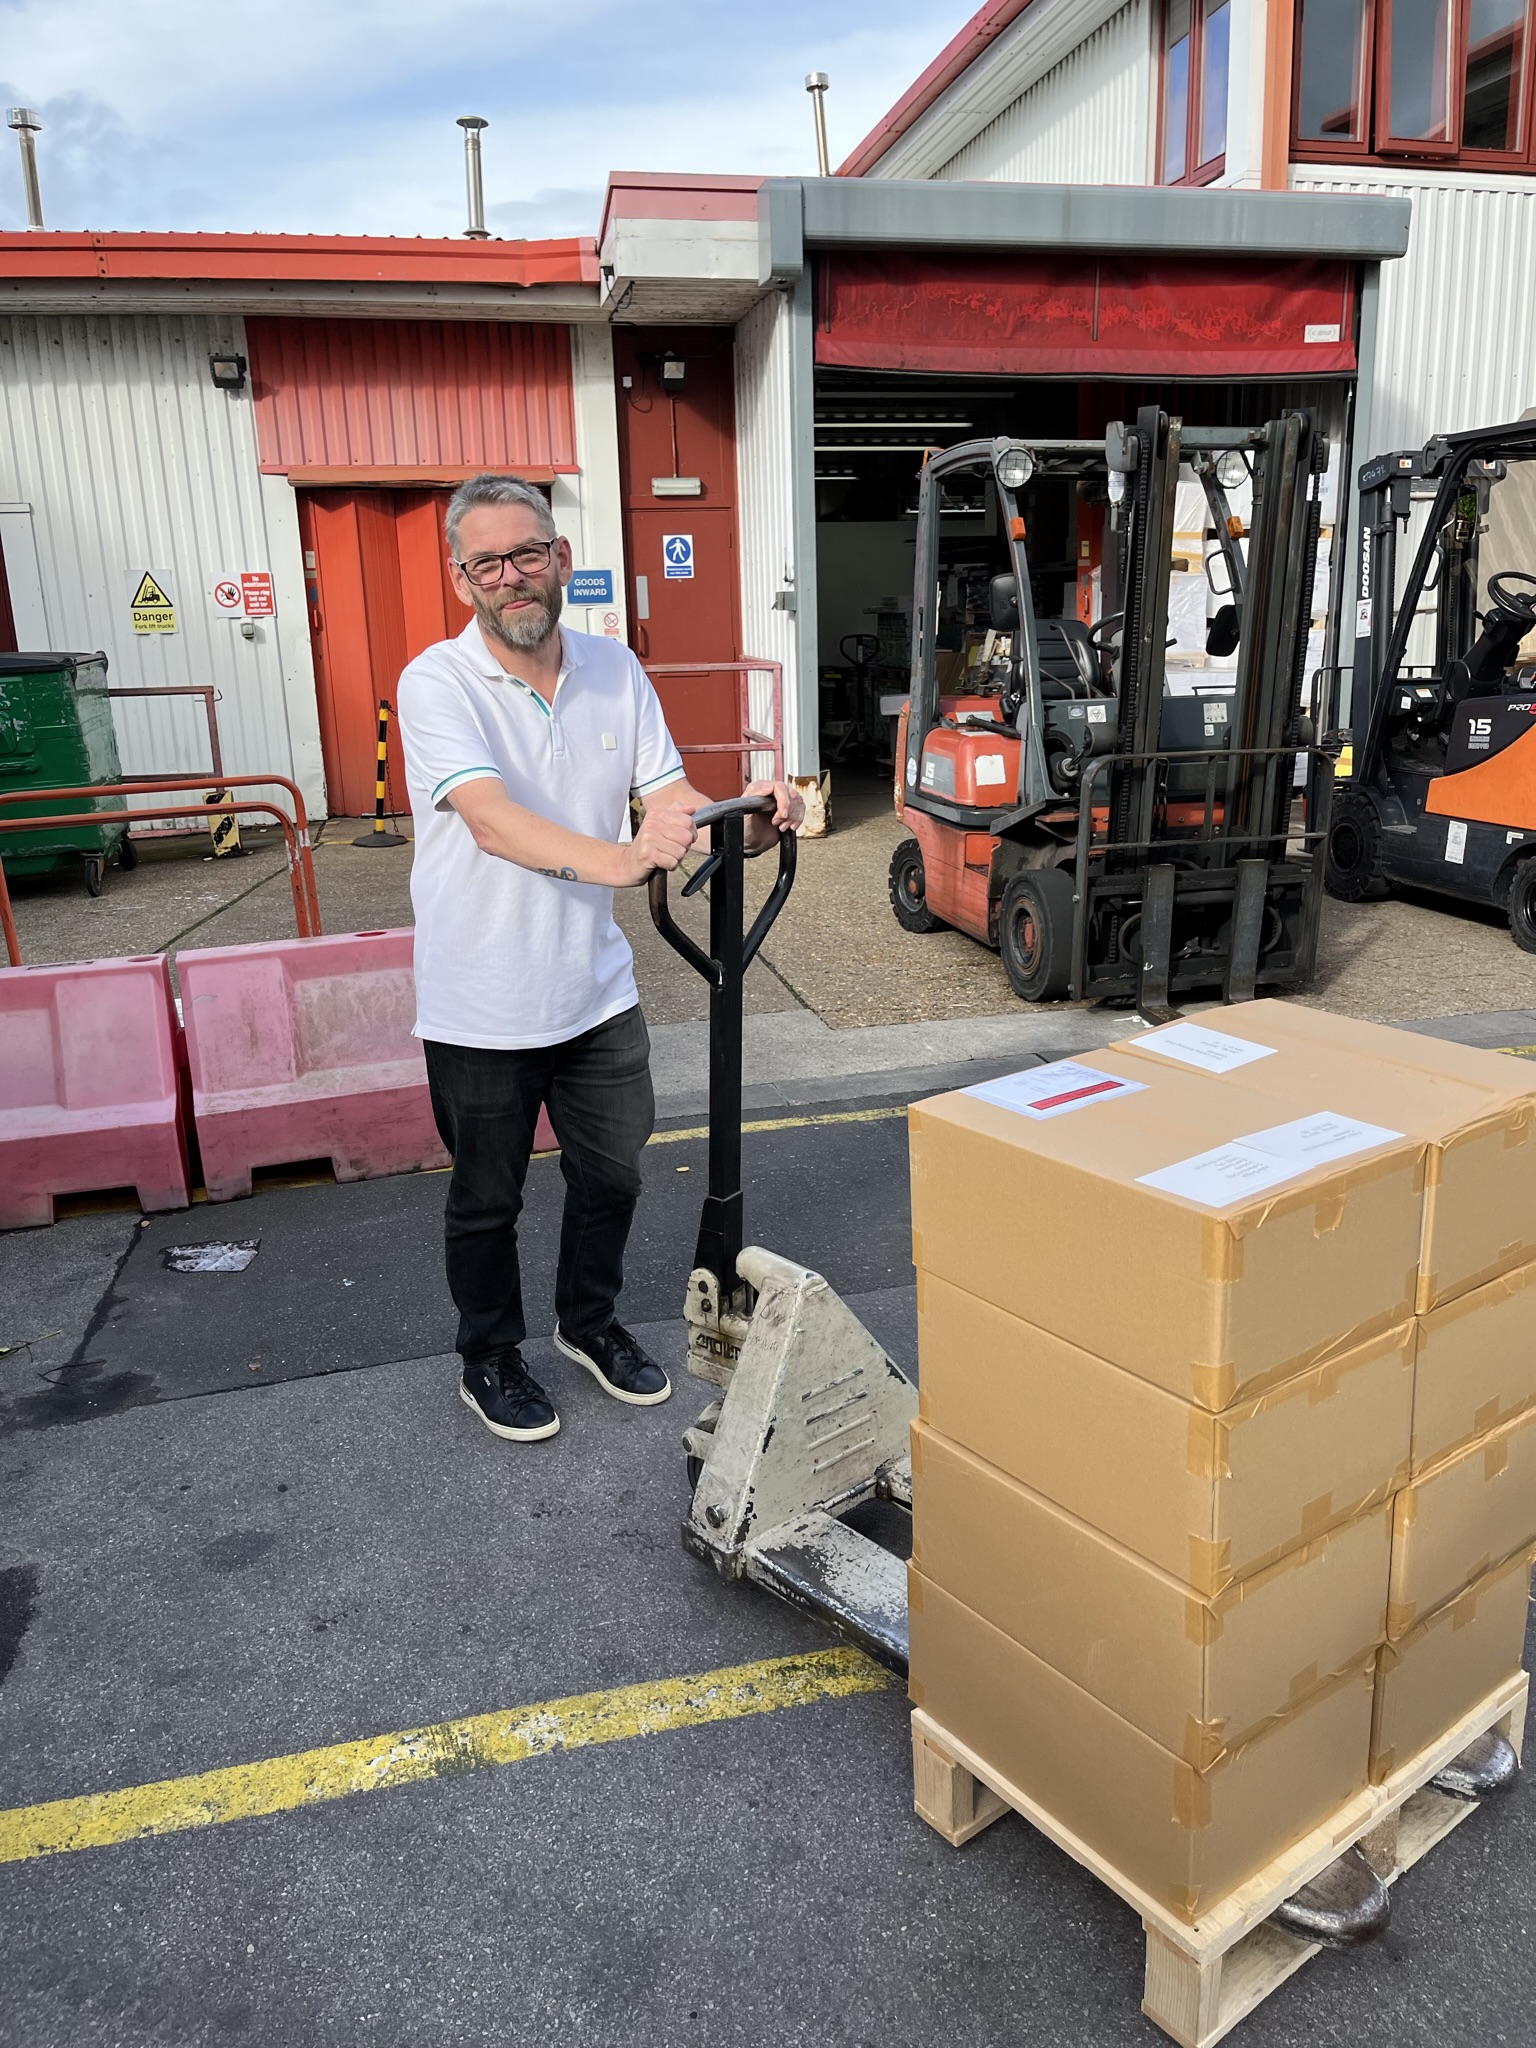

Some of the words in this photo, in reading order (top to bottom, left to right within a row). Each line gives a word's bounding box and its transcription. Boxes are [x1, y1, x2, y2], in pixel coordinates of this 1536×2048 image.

[1361, 526, 1371, 598] DOOSAN
[133, 612, 173, 623] Danger
[1468, 718, 1492, 735] 15
